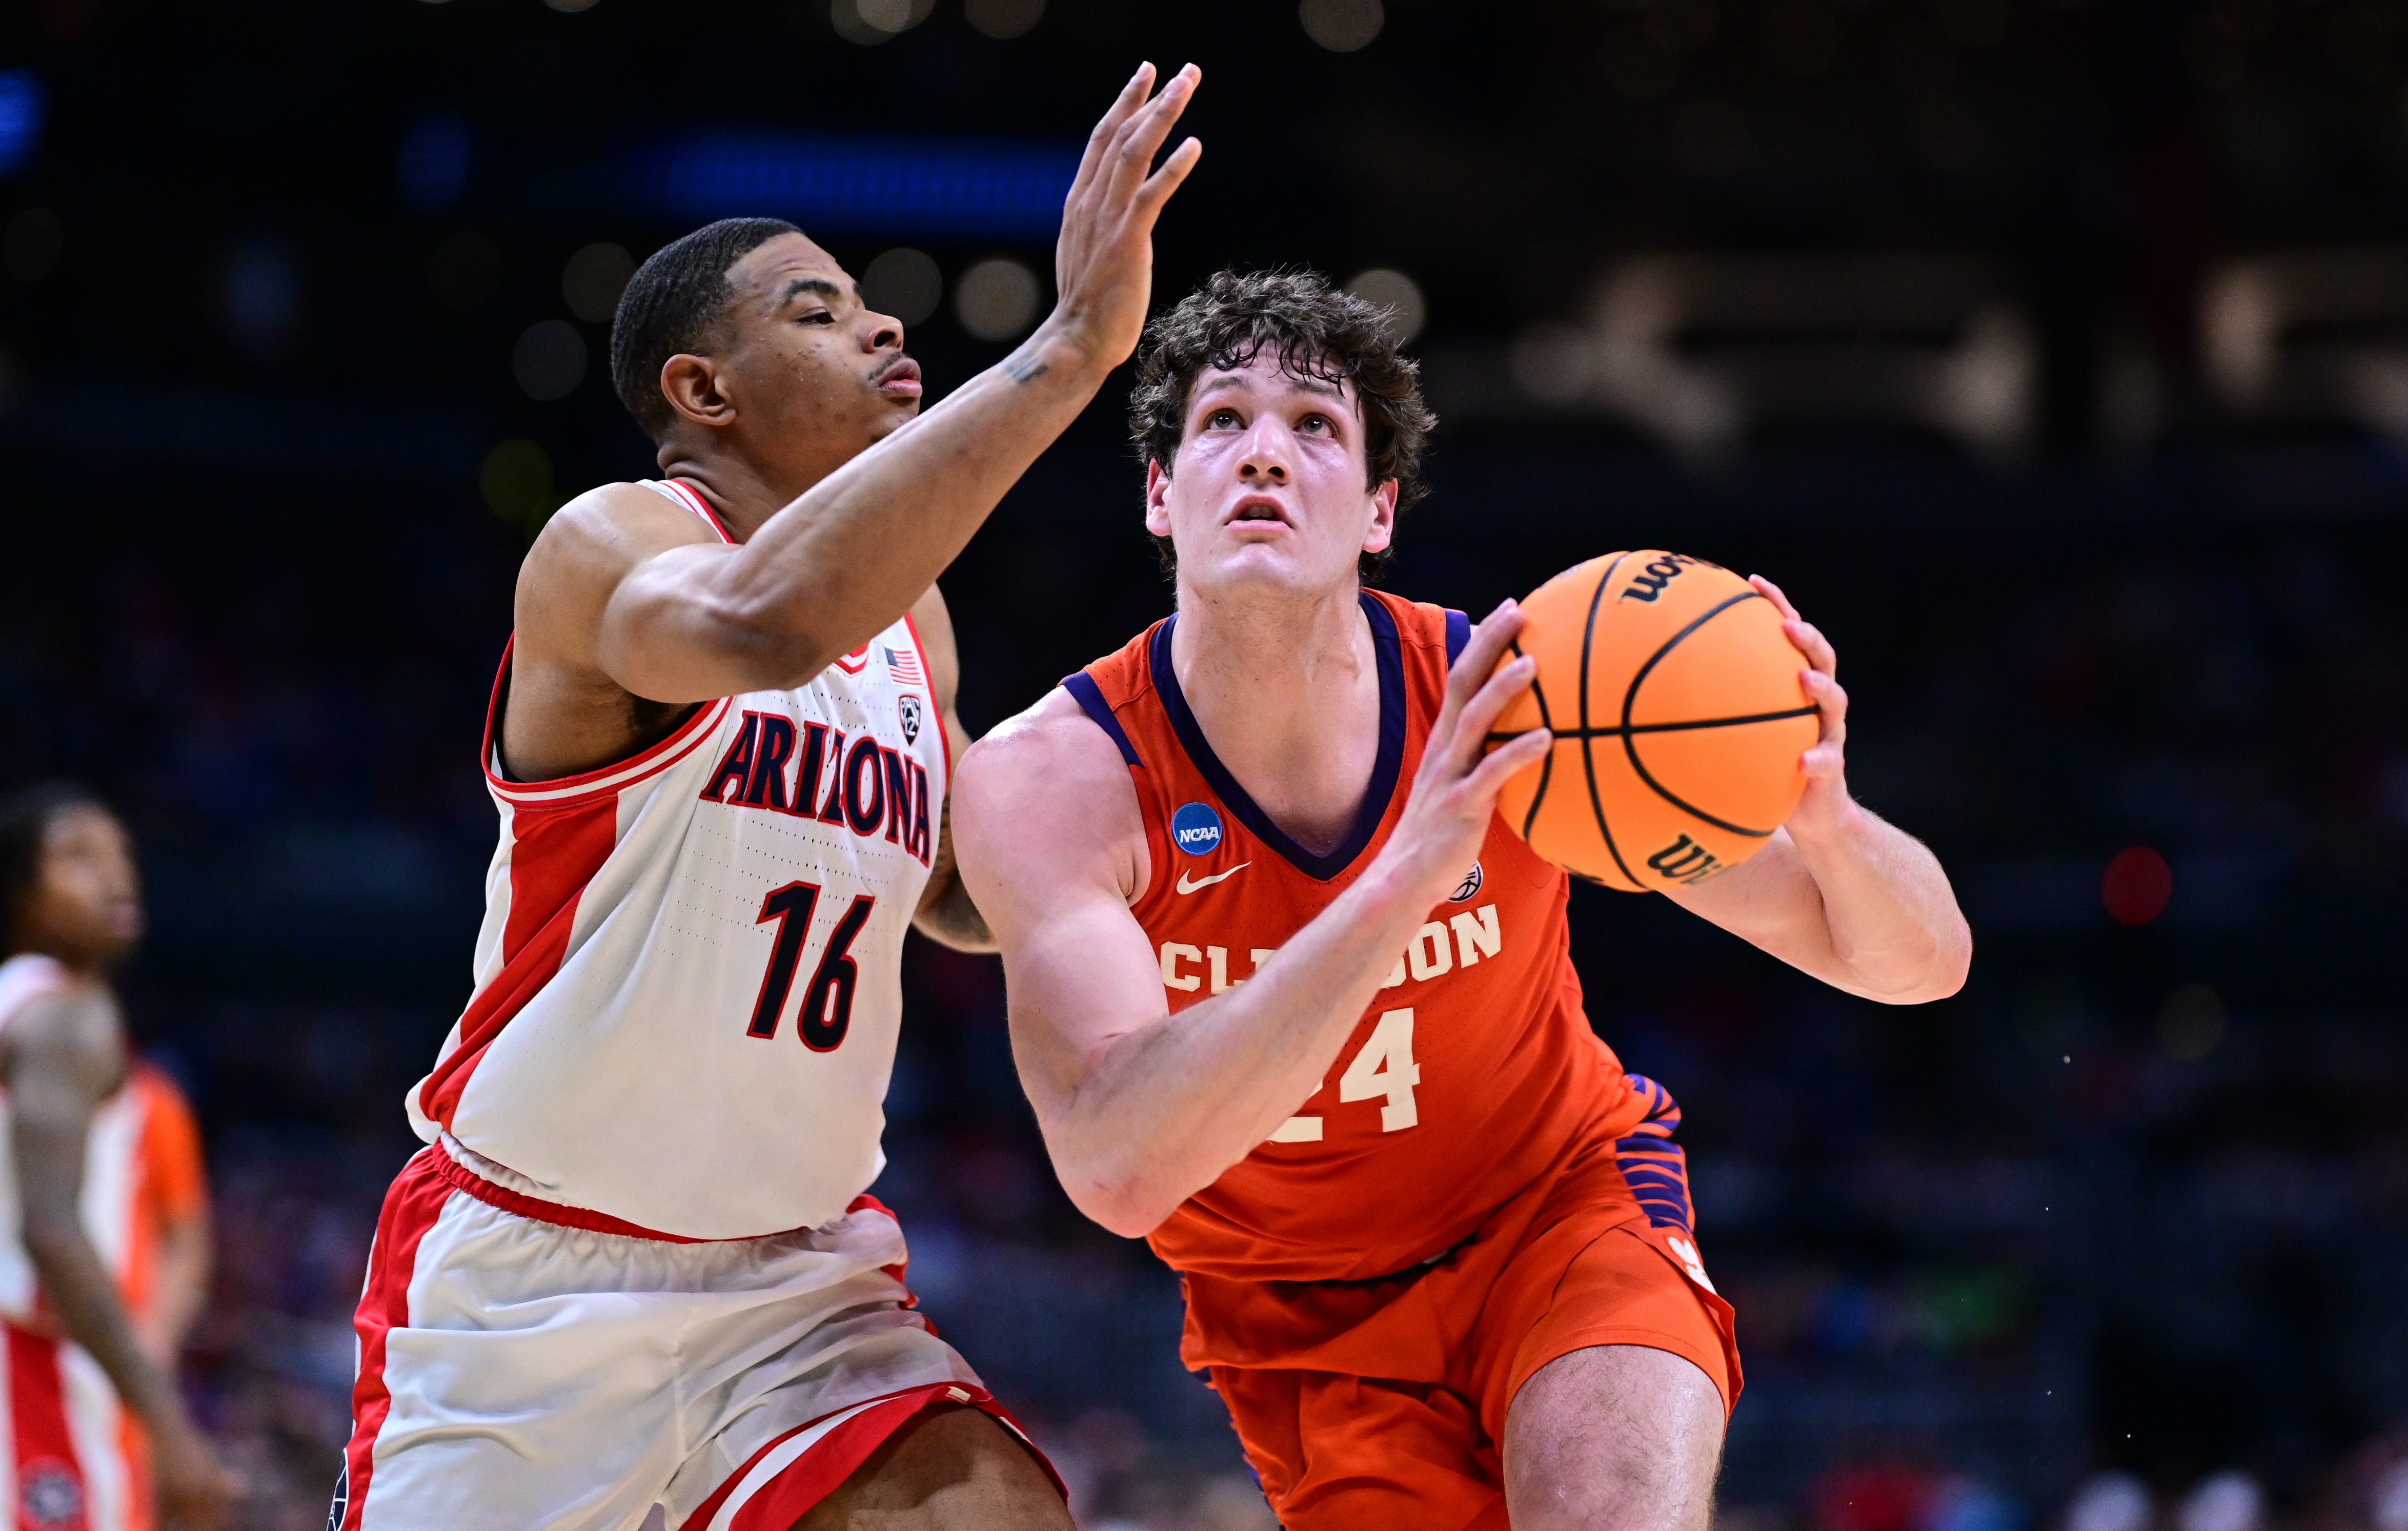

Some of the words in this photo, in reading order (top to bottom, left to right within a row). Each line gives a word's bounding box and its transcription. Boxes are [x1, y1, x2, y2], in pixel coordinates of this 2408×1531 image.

[699, 710, 929, 868] ARIZONA
[1180, 826, 1219, 843] NCAA
[746, 880, 876, 1053] 16
[1161, 904, 1502, 995] CLON
[1266, 1007, 1421, 1142] 4
